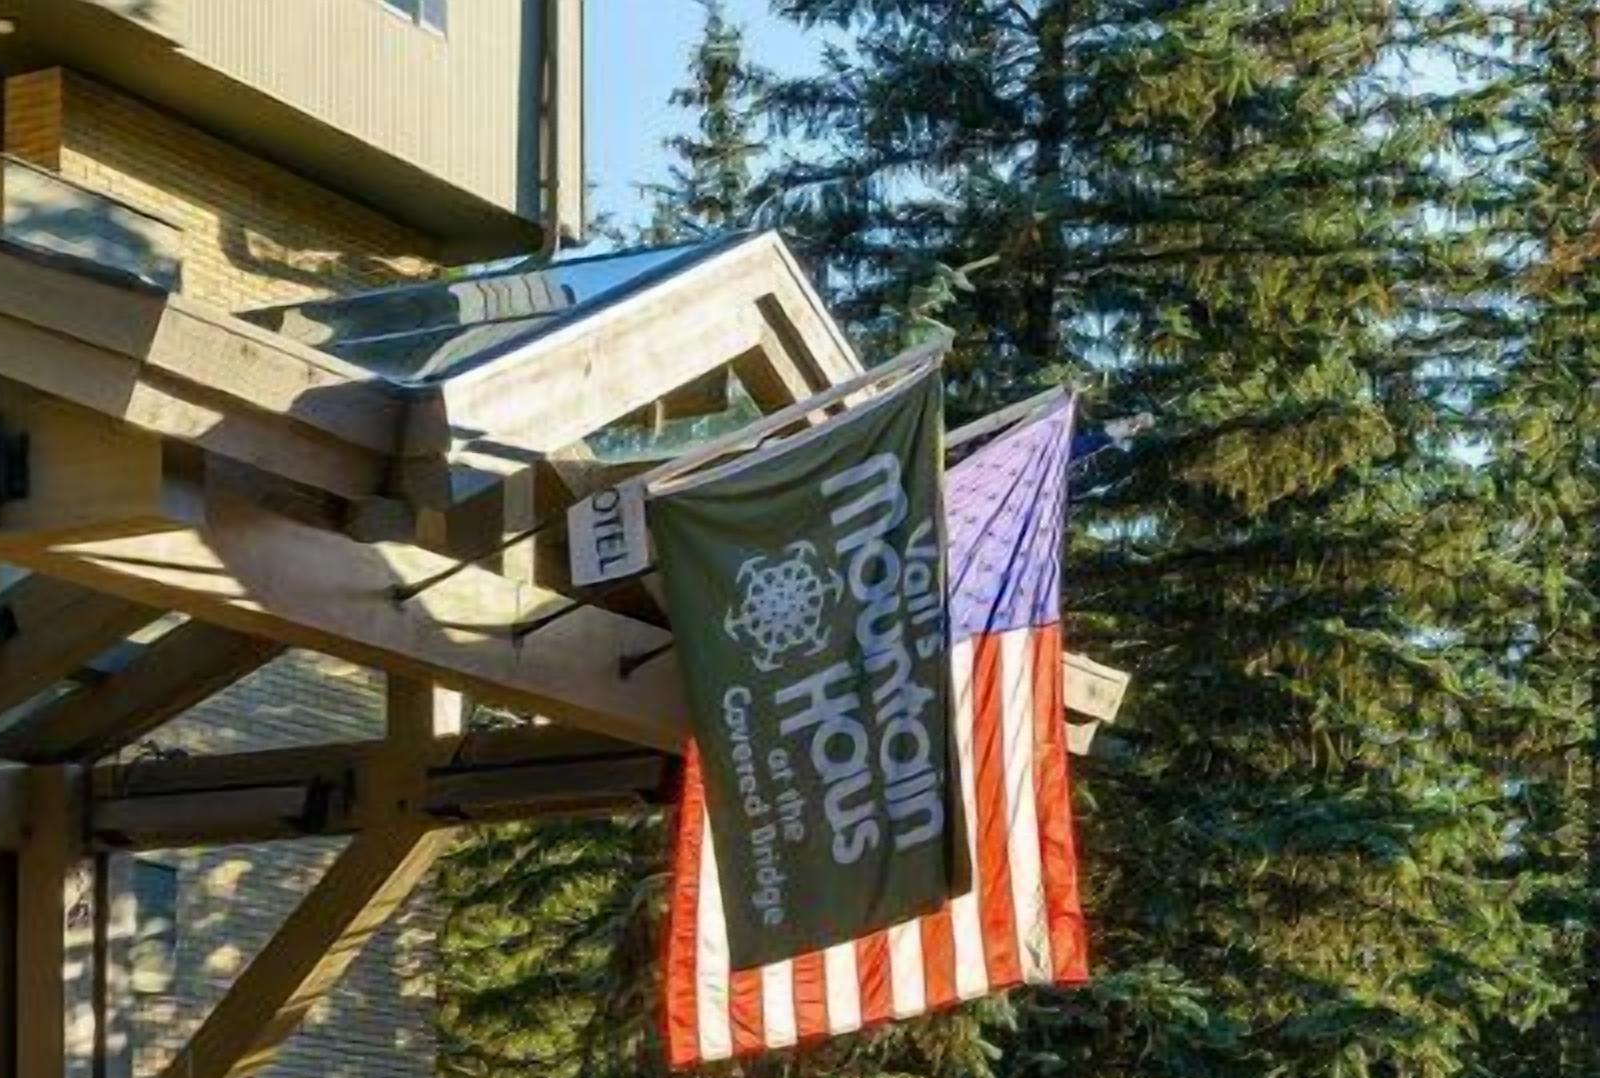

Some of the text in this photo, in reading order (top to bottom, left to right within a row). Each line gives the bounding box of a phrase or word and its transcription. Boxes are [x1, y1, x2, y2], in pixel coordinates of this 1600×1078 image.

[821, 452, 944, 849] Mountain
[723, 686, 788, 925] Covered Bridge
[768, 748, 805, 842] at the
[775, 661, 880, 864] Haus
